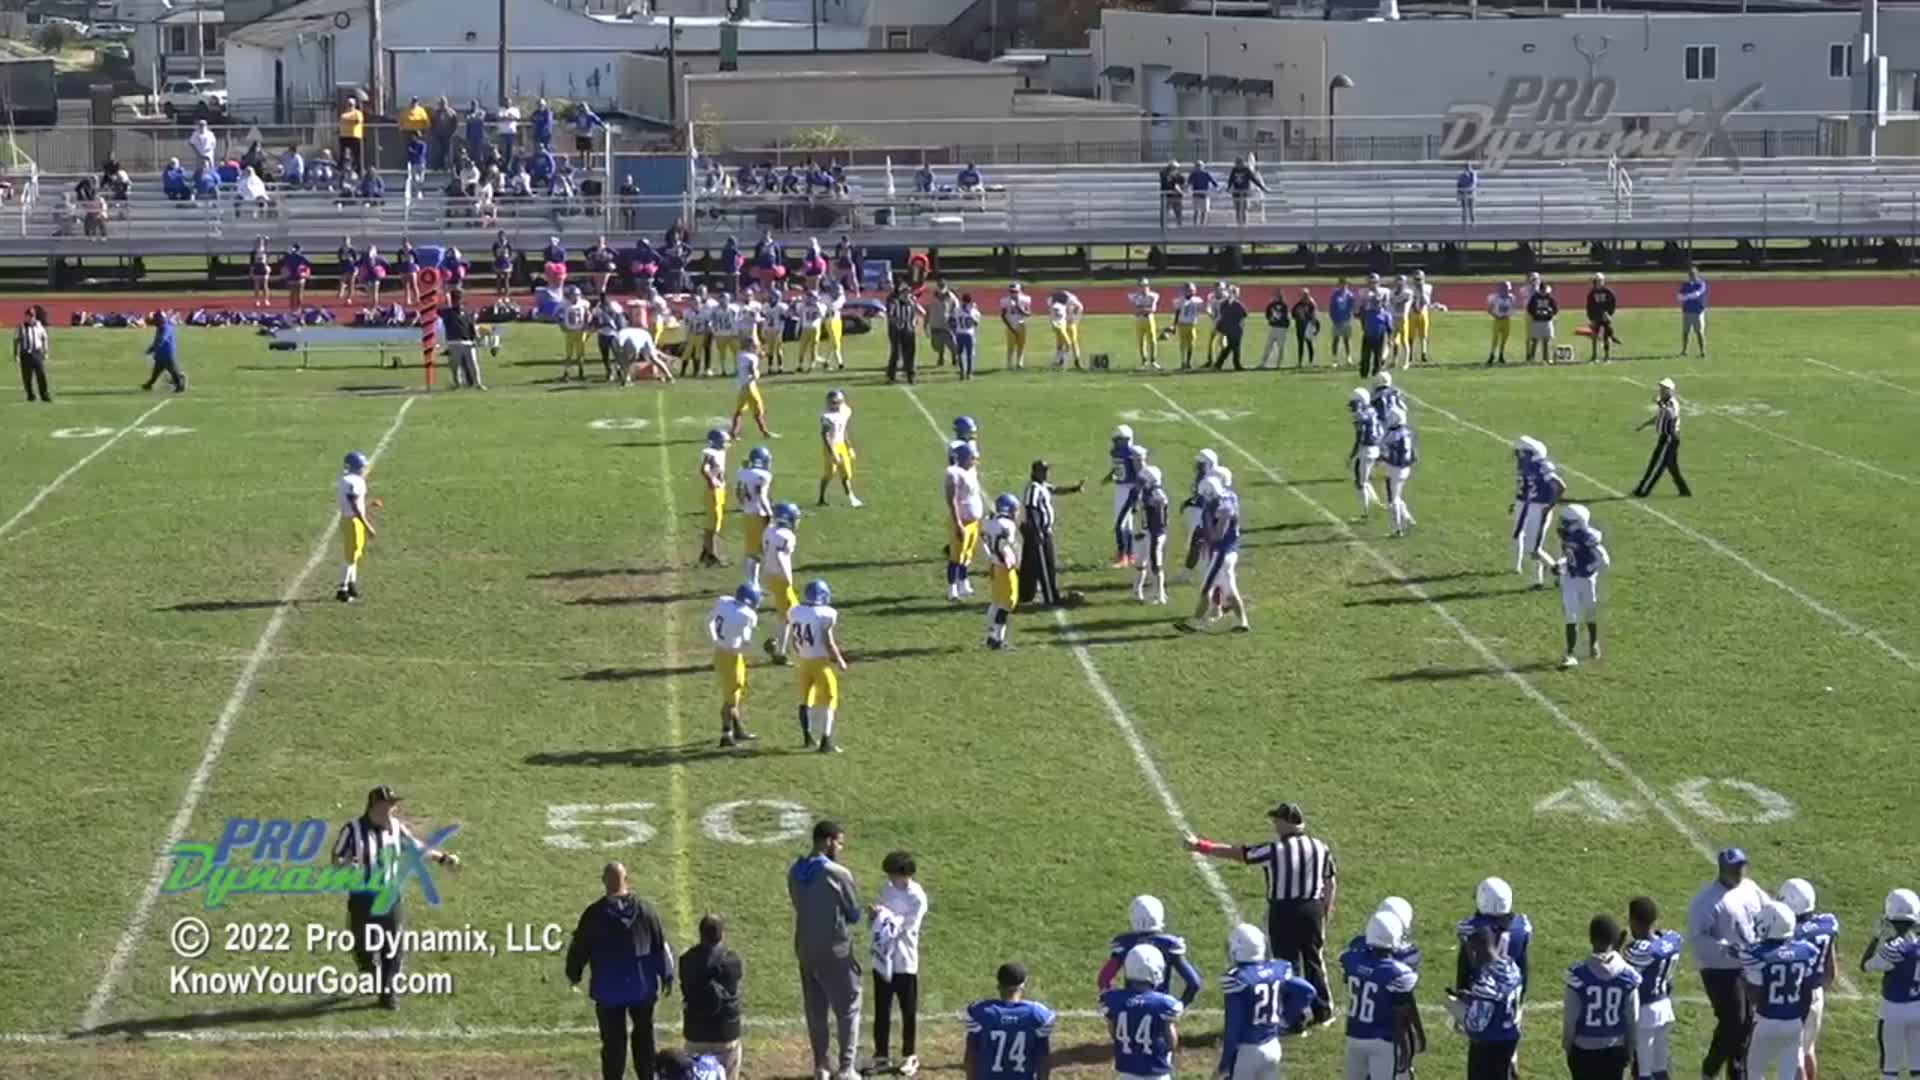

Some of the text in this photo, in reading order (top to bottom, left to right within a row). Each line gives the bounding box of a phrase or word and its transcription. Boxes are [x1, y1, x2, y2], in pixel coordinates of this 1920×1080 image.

[1254, 979, 1281, 1025] 21
[1769, 962, 1805, 1004] 23
[1585, 985, 1622, 1026] 28
[990, 1030, 1026, 1072] 74
[1116, 1010, 1153, 1055] 44
